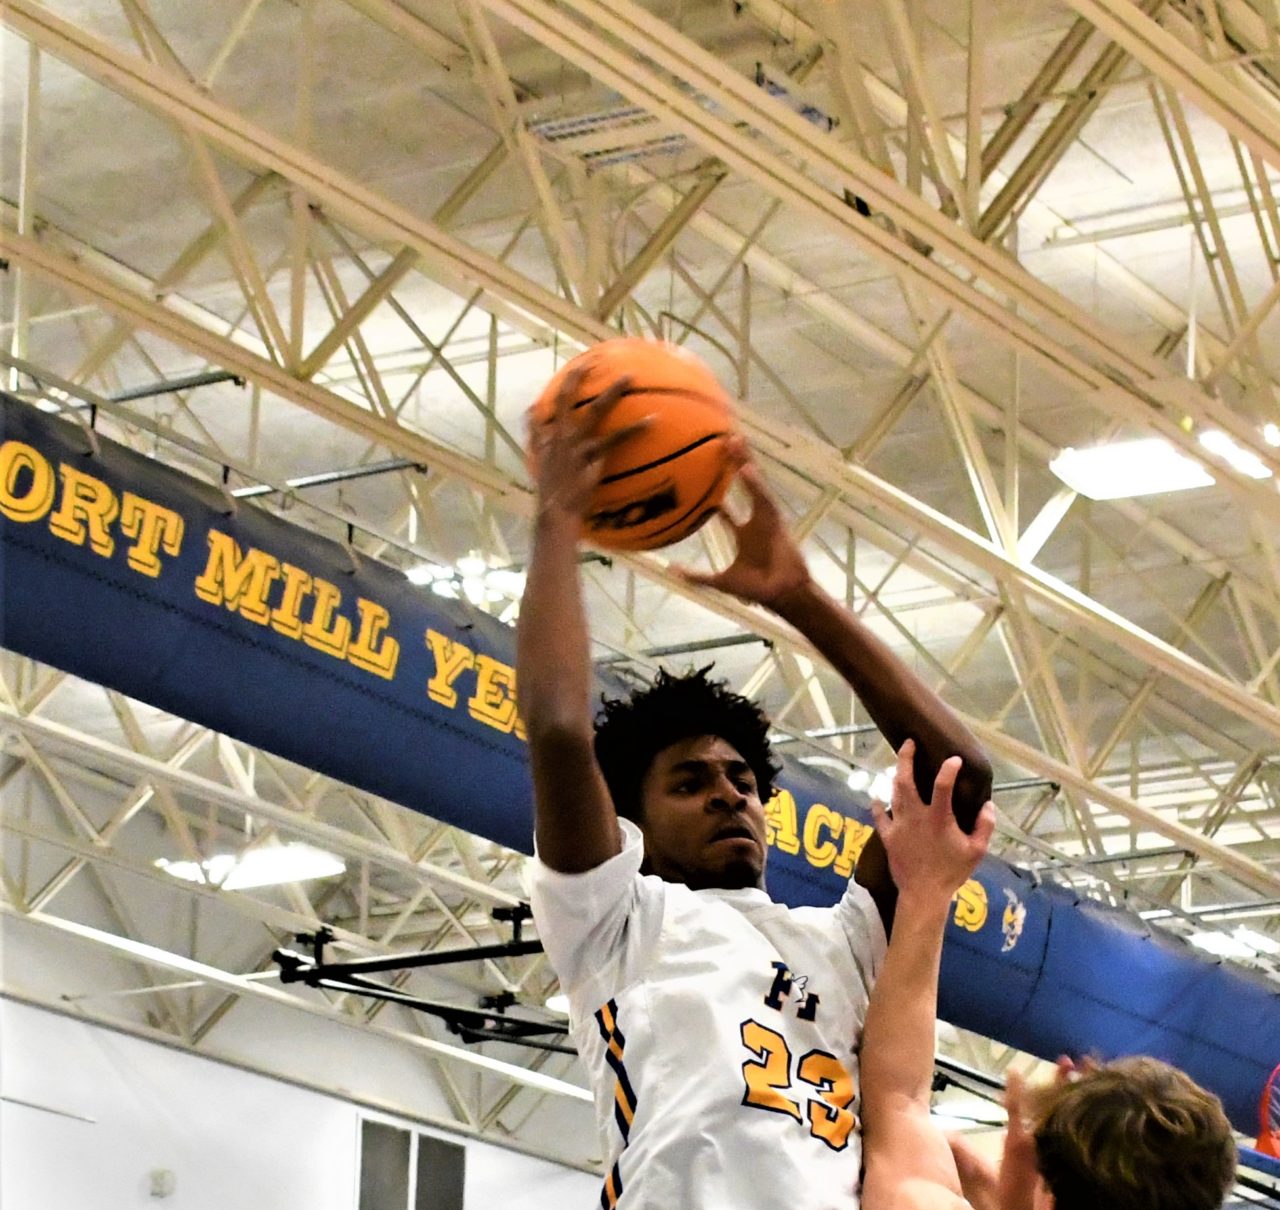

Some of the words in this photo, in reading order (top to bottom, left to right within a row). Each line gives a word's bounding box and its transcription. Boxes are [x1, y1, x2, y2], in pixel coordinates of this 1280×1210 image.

[195, 529, 400, 680] MILL
[426, 628, 528, 741] YE
[740, 1018, 856, 1152] 23
